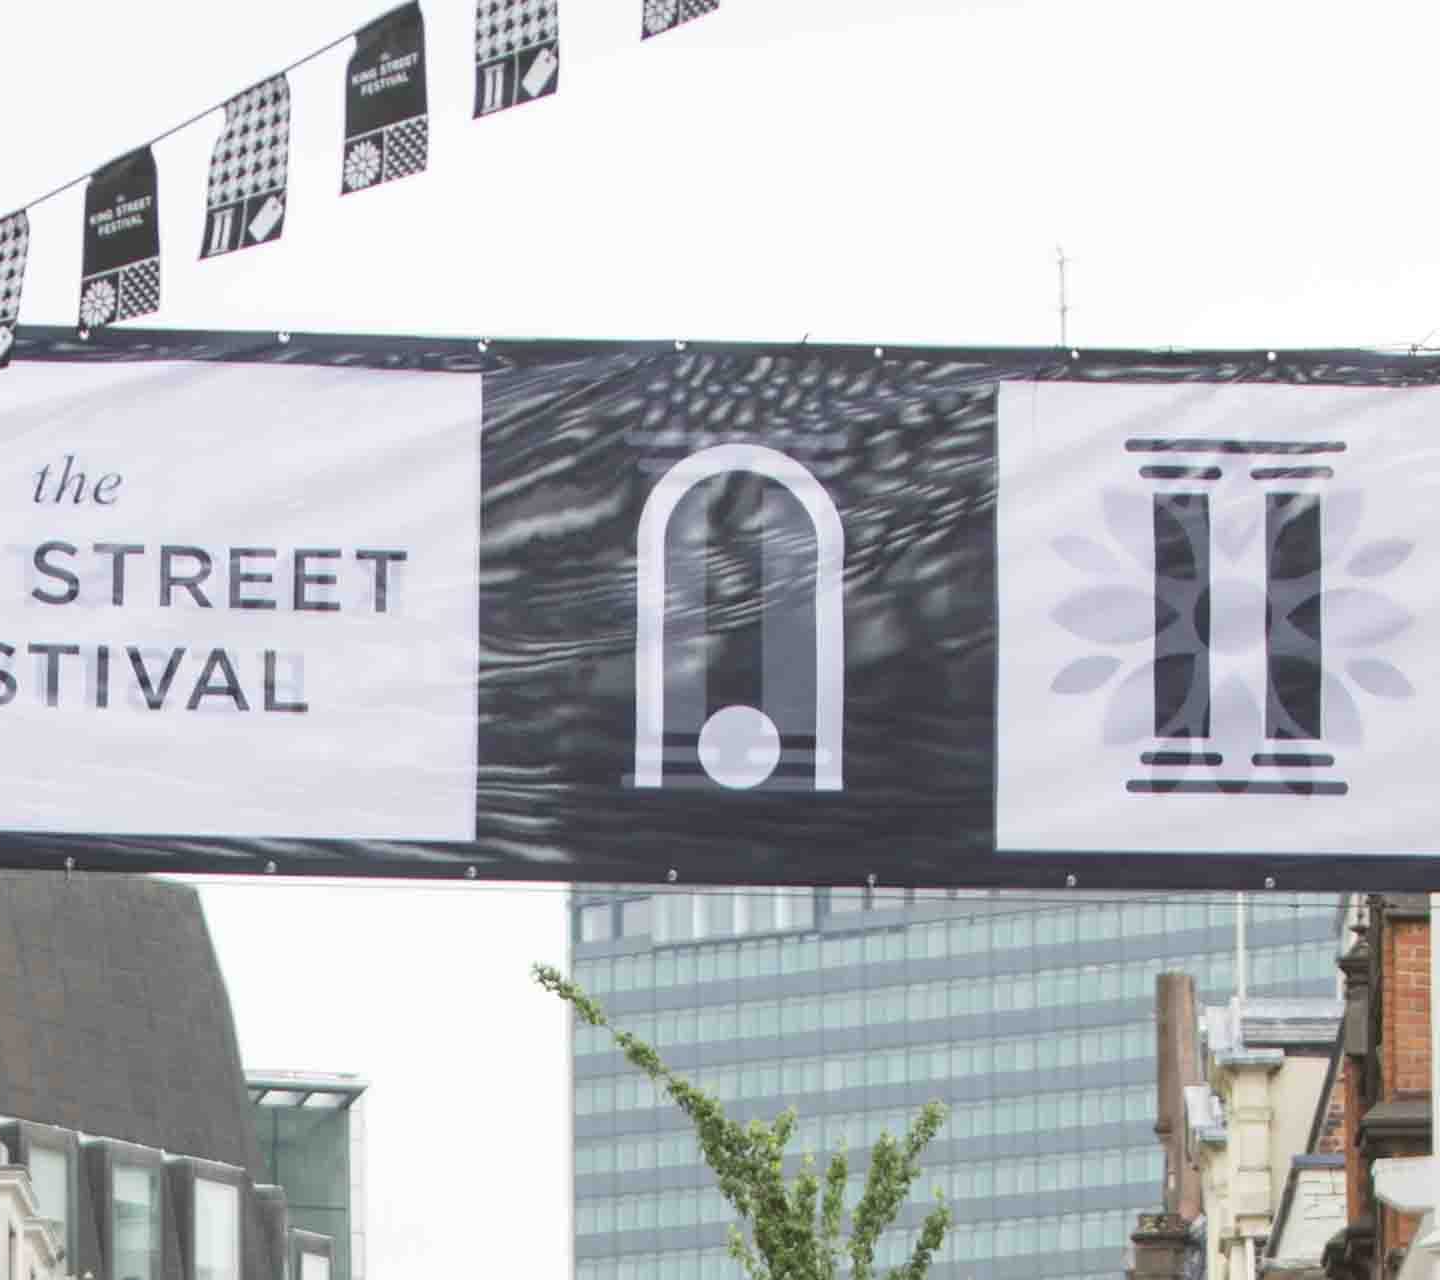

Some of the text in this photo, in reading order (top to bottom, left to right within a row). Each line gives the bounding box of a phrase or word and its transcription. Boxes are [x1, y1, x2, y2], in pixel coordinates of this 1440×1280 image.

[352, 52, 418, 86] KING STREET
[361, 71, 408, 96] FESTIVAL
[31, 453, 123, 506] the
[31, 541, 408, 613] STREET
